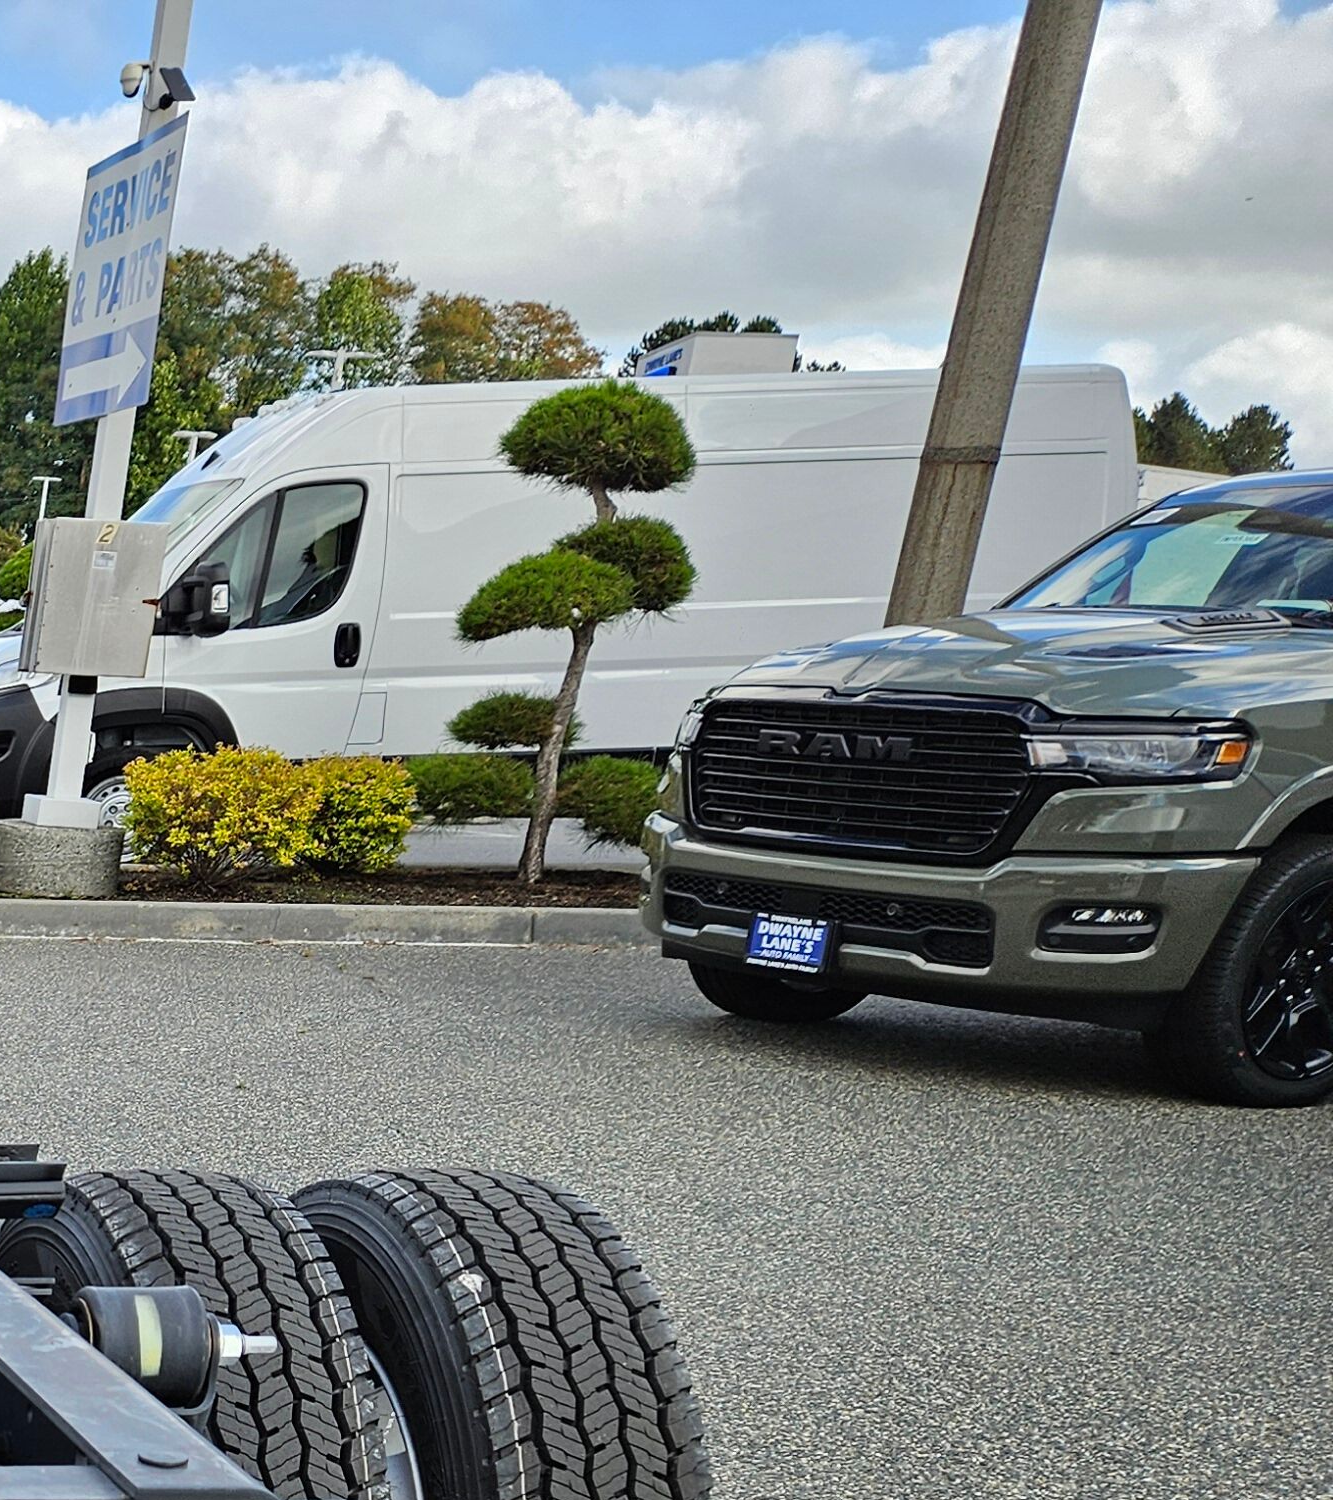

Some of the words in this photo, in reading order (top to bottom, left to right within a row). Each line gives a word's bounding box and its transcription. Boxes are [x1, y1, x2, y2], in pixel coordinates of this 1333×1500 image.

[85, 152, 176, 248] SERVICE
[71, 271, 86, 327] &
[95, 237, 163, 318] PARTS
[98, 524, 115, 543] 2
[757, 729, 914, 761] RAM
[757, 920, 824, 941] DWAYNE
[761, 935, 814, 954] LANE'S
